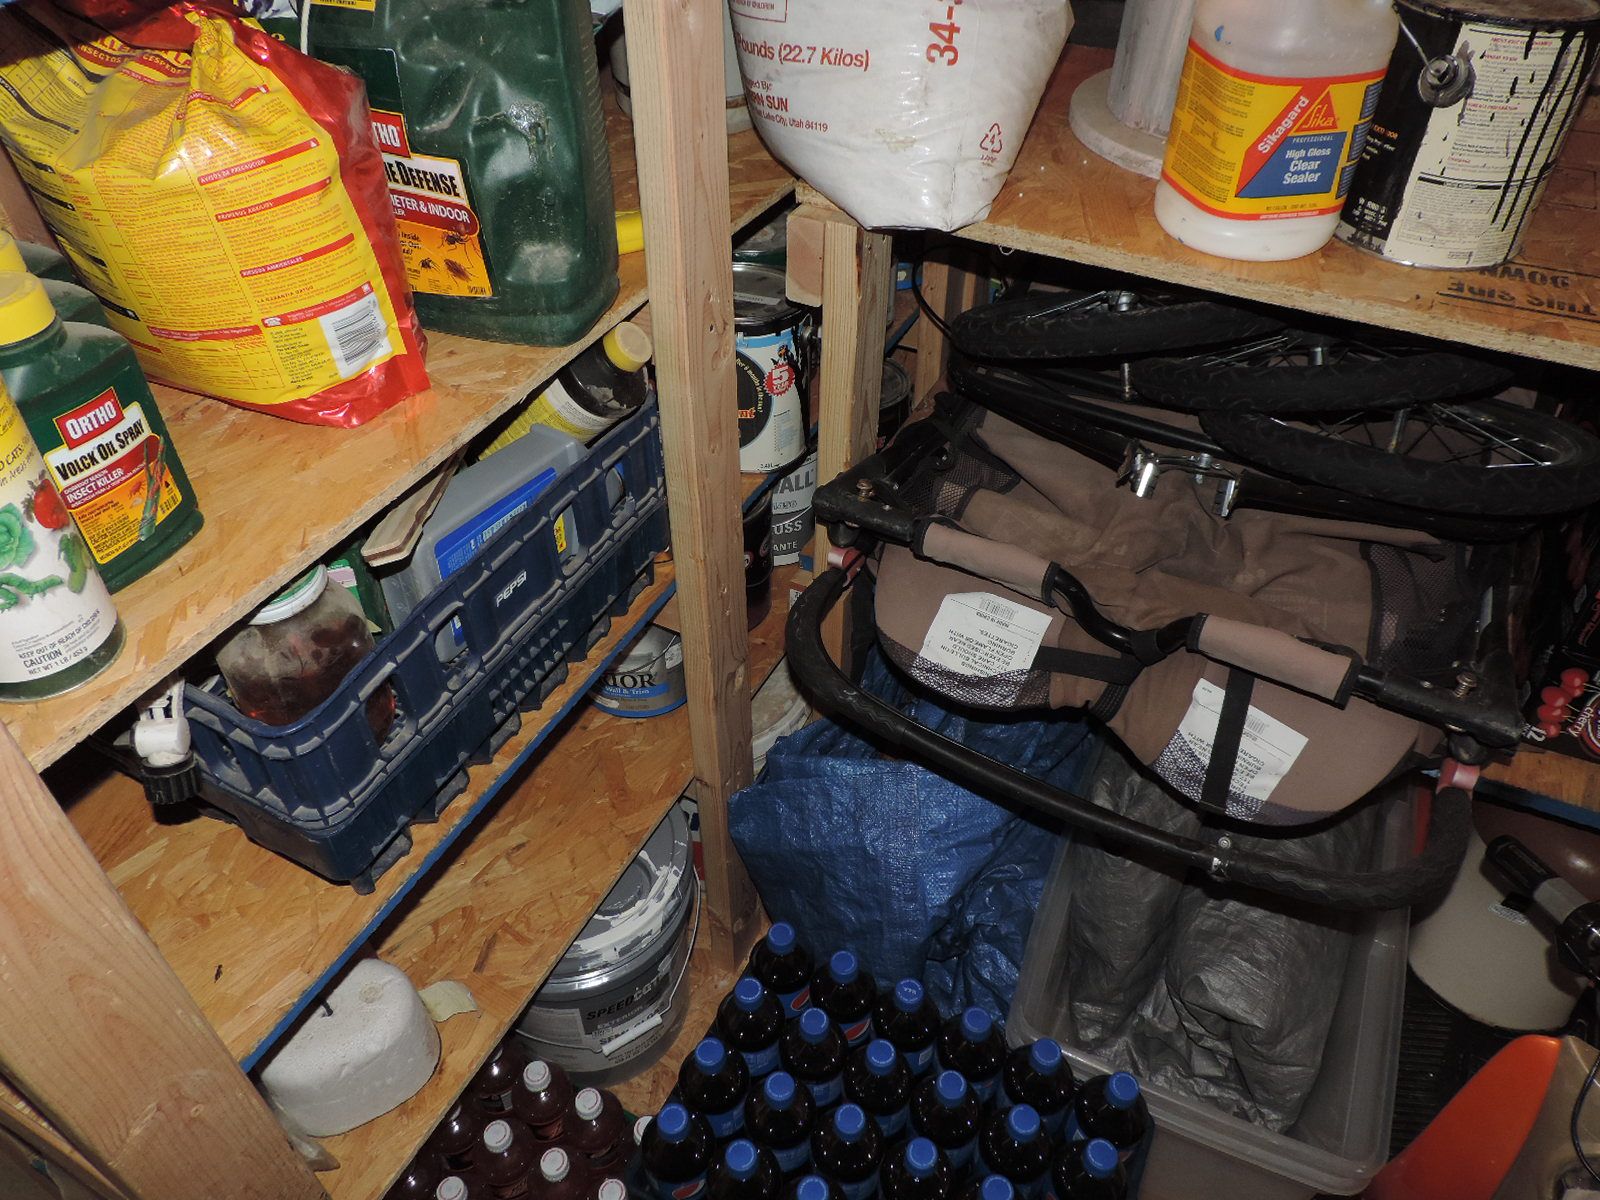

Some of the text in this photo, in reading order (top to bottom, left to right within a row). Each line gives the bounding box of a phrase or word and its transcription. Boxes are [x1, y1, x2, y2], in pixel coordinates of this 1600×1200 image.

[926, 0, 963, 66] 34-
[736, 32, 870, 72] Pounds (22.7 Kilos)
[766, 95, 788, 112] SUN
[1302, 104, 1334, 129] Sika
[372, 122, 400, 148] THO
[1258, 95, 1310, 154] Sikagard
[1285, 148, 1331, 160] High Gloss
[1290, 160, 1321, 172] Clear
[395, 159, 460, 197] DEFENSE
[1283, 172, 1321, 184] Sealer
[429, 204, 470, 223] INDOOR
[772, 366, 789, 385] 5
[66, 401, 117, 440] ORTHO
[55, 420, 145, 481] VOLCK OIL SPRAY
[67, 466, 125, 503] INSECT KILLER
[773, 541, 797, 552] ANTE
[496, 571, 527, 606] PEPSI
[24, 649, 62, 668] CAUTION
[1569, 706, 1594, 738] cherry
